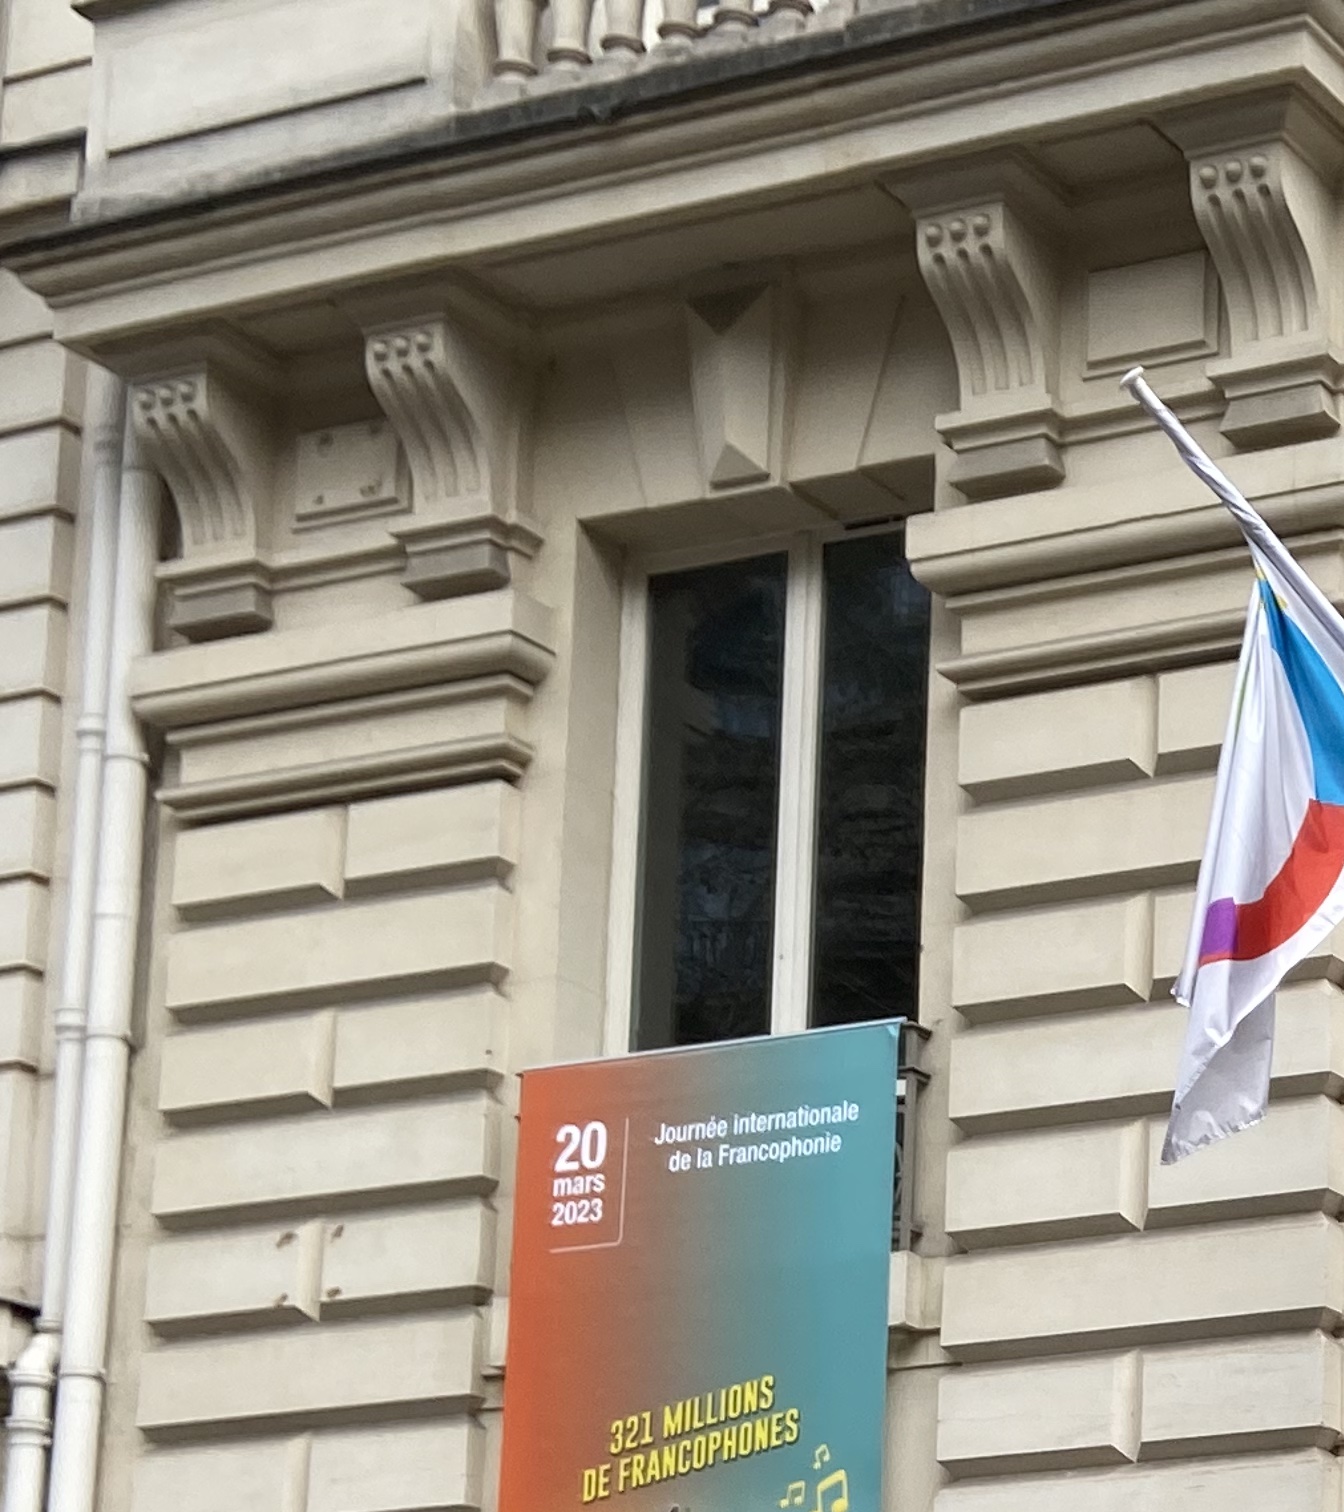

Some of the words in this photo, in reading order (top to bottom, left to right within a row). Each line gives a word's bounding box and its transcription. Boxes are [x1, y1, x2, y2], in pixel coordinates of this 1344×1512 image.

[654, 1115, 727, 1145] Journée
[733, 1100, 859, 1134] internationale
[554, 1120, 608, 1172] 20
[669, 1150, 690, 1172] de
[697, 1148, 713, 1169] la
[719, 1131, 842, 1167] Francophonie
[552, 1173, 605, 1197] mars
[551, 1199, 603, 1227] 2023
[609, 1411, 654, 1454] 321
[662, 1374, 775, 1439] MILLIONS
[582, 1463, 611, 1502] DE
[618, 1408, 799, 1492] FRANCOPHONES
